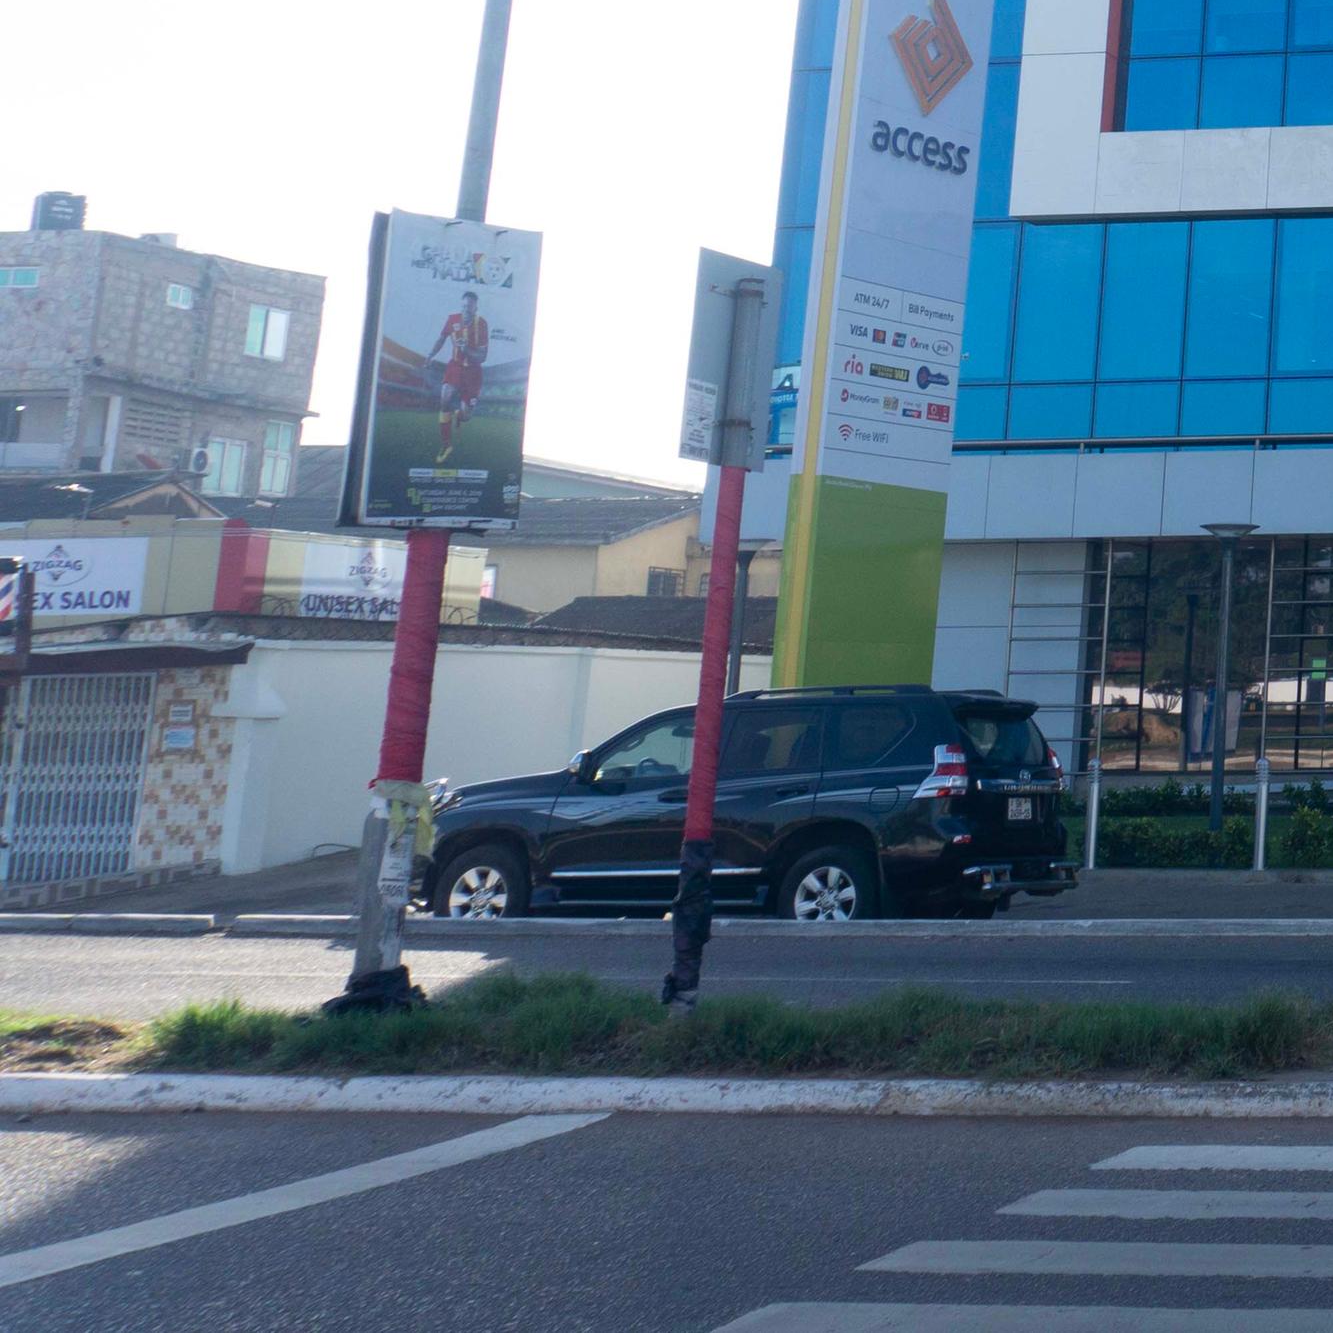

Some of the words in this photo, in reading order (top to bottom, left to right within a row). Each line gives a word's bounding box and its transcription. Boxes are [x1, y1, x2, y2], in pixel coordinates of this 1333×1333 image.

[871, 119, 971, 175] access
[854, 292, 871, 305] ATM
[871, 296, 890, 310] 24/7
[908, 303, 920, 314] Bill
[920, 306, 955, 322] Payments
[850, 324, 869, 338] VISA
[844, 353, 864, 375] ria
[849, 393, 881, 405] MoneyGram
[854, 428, 871, 442] Free
[32, 559, 83, 572] ZIGZAG
[60, 590, 131, 610] SALON
[303, 593, 365, 614] UNISEX
[368, 596, 400, 616] SAL
